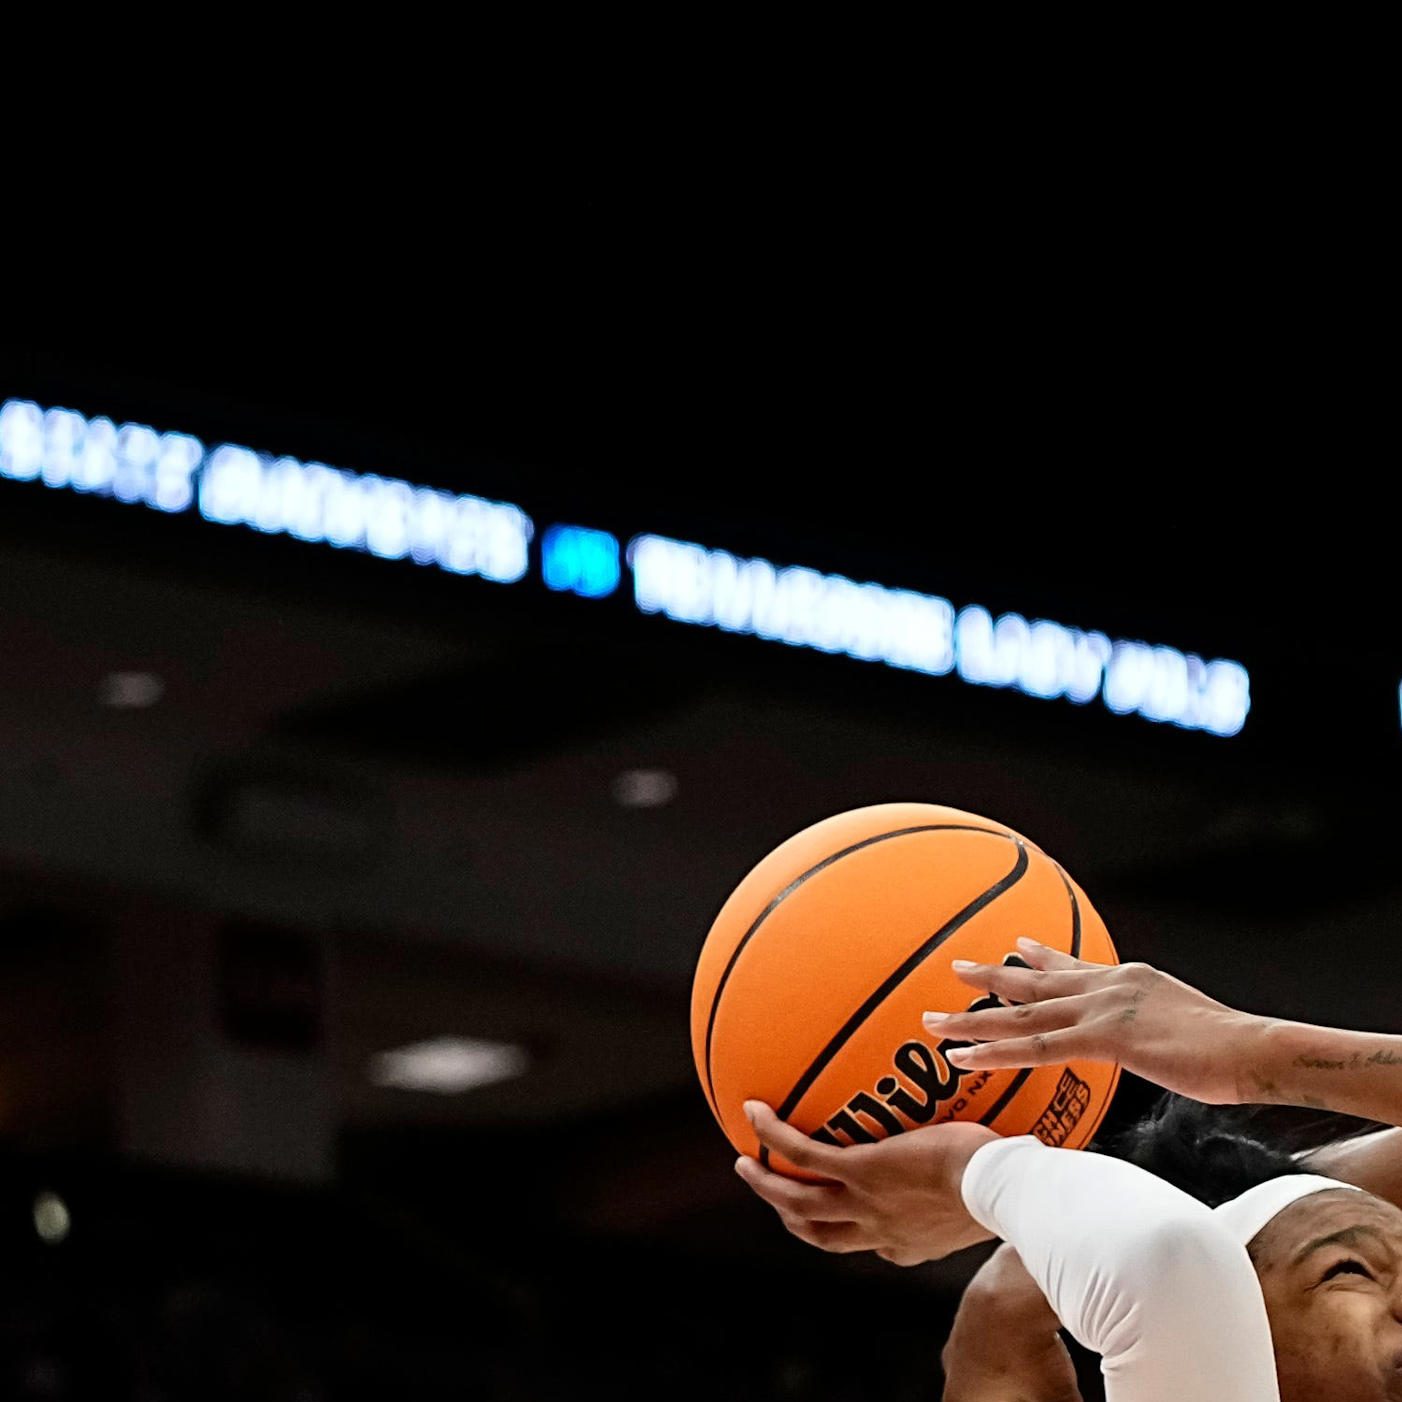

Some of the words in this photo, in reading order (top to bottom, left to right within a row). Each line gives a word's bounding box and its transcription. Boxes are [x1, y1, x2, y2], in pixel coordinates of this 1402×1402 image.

[940, 1097, 967, 1123] VO
[967, 1070, 993, 1096] NX
[1045, 1083, 1087, 1146] NESS
